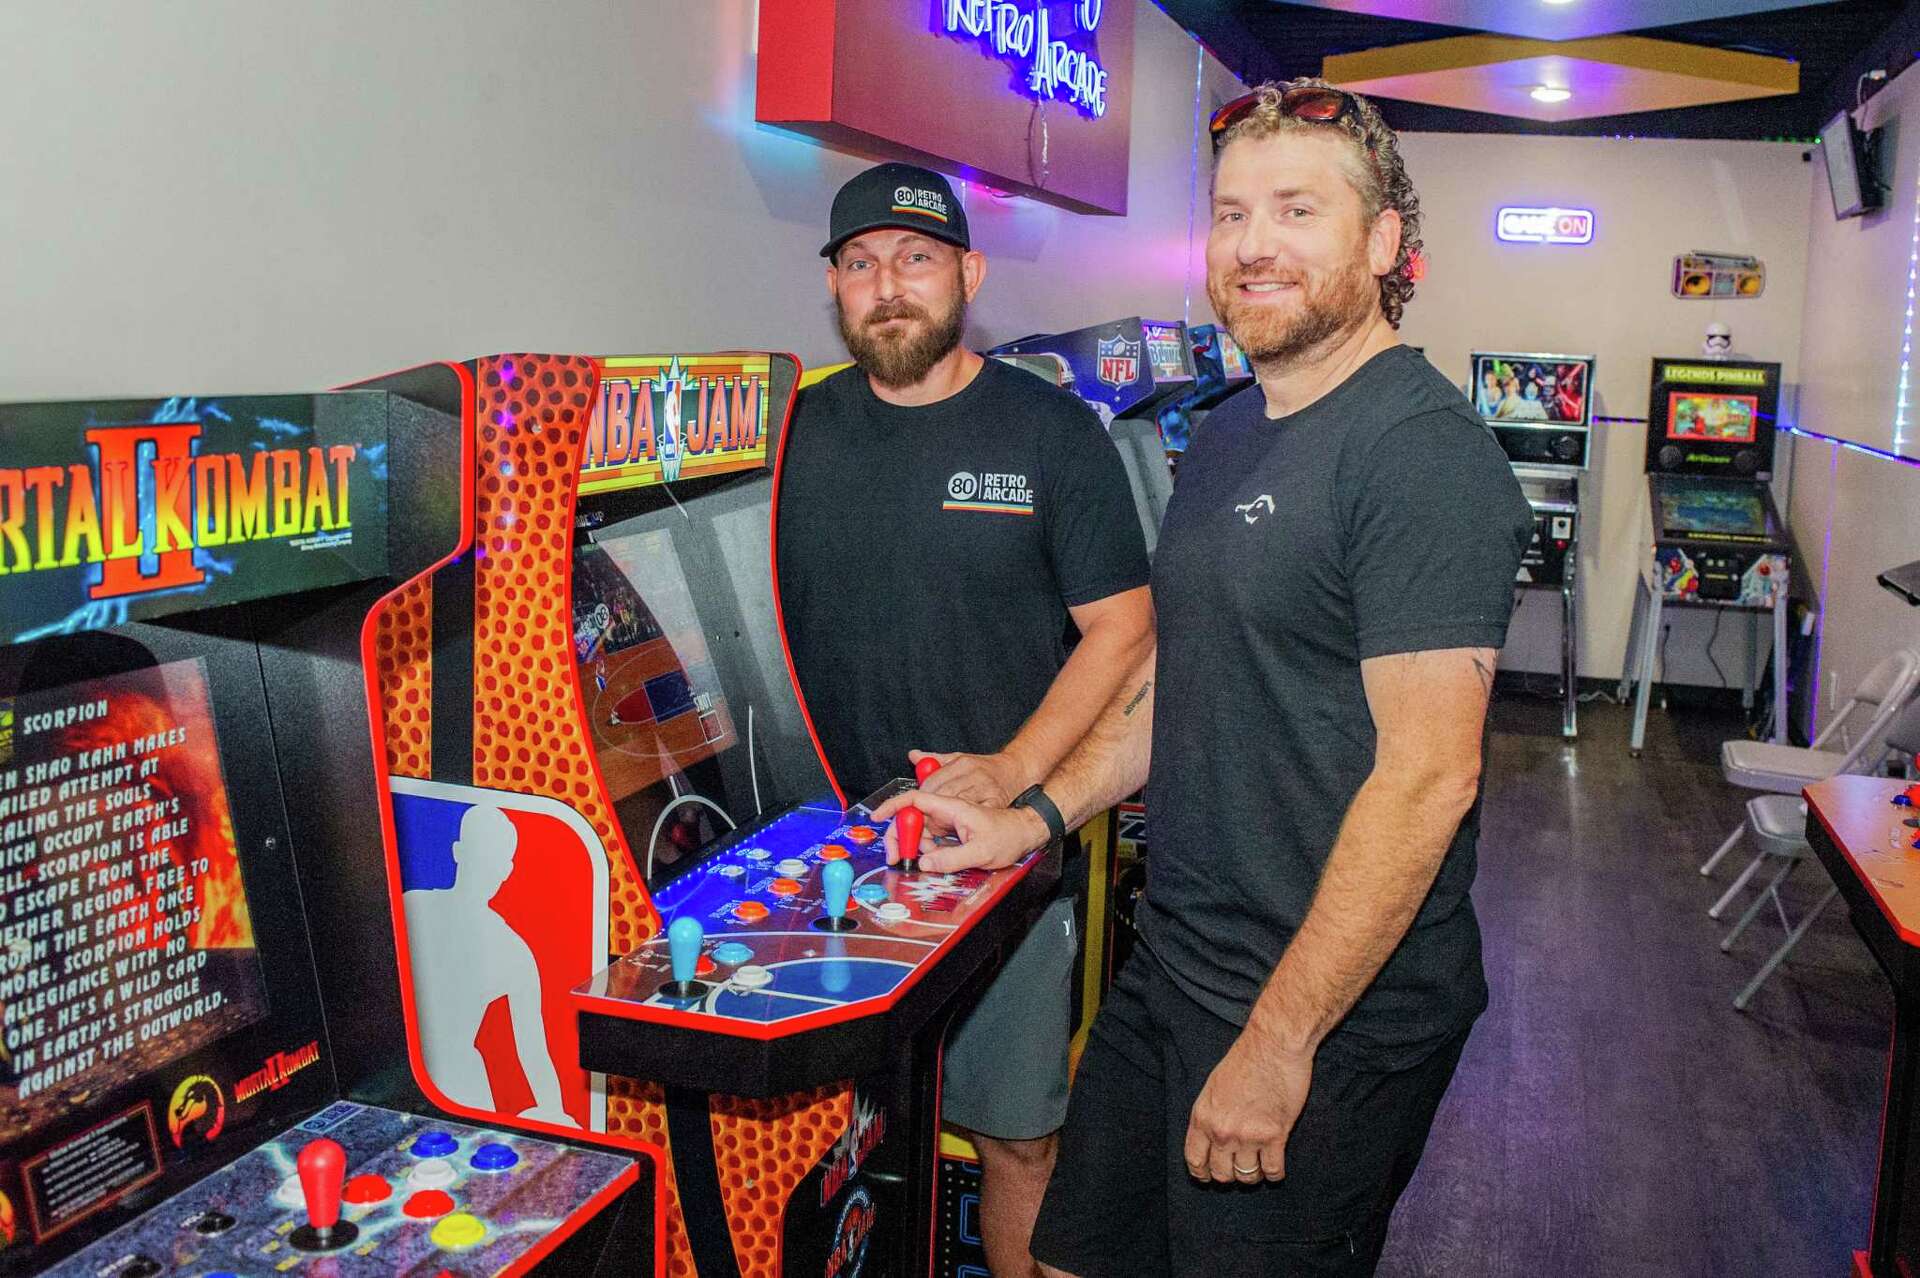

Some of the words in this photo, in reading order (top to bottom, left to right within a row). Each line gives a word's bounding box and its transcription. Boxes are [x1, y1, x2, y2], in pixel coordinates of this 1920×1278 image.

[1029, 8, 1107, 117] ARCADE
[896, 188, 912, 203] 80
[917, 189, 942, 203] RETRO
[917, 198, 947, 214] ARCADE
[1558, 216, 1587, 235] ON
[1102, 358, 1134, 382] NFL
[580, 379, 658, 469] NBA
[687, 376, 761, 455] JAM
[151, 445, 356, 553] KOMBAT
[951, 477, 975, 495] 80
[983, 488, 1033, 503] ARCADE
[984, 473, 1026, 488] RETRO
[23, 700, 108, 735] SCORPION
[26, 757, 71, 785] SHAO
[79, 742, 126, 770] KAHN
[134, 727, 186, 755] MAKES
[59, 764, 133, 802] ATTEMPT
[140, 757, 159, 778] AT
[0, 809, 58, 843] ALING
[64, 798, 97, 823] THE
[105, 783, 151, 811] SOULS
[43, 820, 104, 854] OCCUPY
[112, 797, 179, 832] EARTH'S
[38, 838, 122, 882] SCORPION
[129, 832, 144, 851] IS
[151, 817, 189, 845] ABLE
[0, 909, 64, 948] ETHER
[146, 865, 185, 894] FREE
[191, 857, 209, 877] TO
[14, 878, 80, 916] ESCAPE
[88, 859, 133, 892] FROM
[139, 847, 170, 871] THE
[0, 939, 47, 975] ROAM
[53, 925, 88, 952] THE
[95, 901, 149, 937] EARTH
[156, 885, 194, 913] ONCE
[0, 964, 57, 999] MORE,
[64, 927, 146, 974] SCORPION
[153, 906, 200, 940] HOLDS
[4, 966, 109, 1026] ALLEGIANCE
[115, 947, 158, 978] WITH
[166, 936, 186, 958] NO
[7, 1018, 53, 1049] ONE.
[57, 997, 97, 1030] HE'S
[103, 988, 114, 1010] A
[119, 970, 161, 1001] WILD
[166, 950, 207, 981] CARD
[14, 1048, 35, 1074] IN
[43, 1013, 116, 1061] EARTH'S
[124, 976, 200, 1025] STRUGGLE
[18, 1047, 96, 1100] AGAINST
[102, 1030, 135, 1060] THE
[140, 991, 228, 1041] OUTWORLD.
